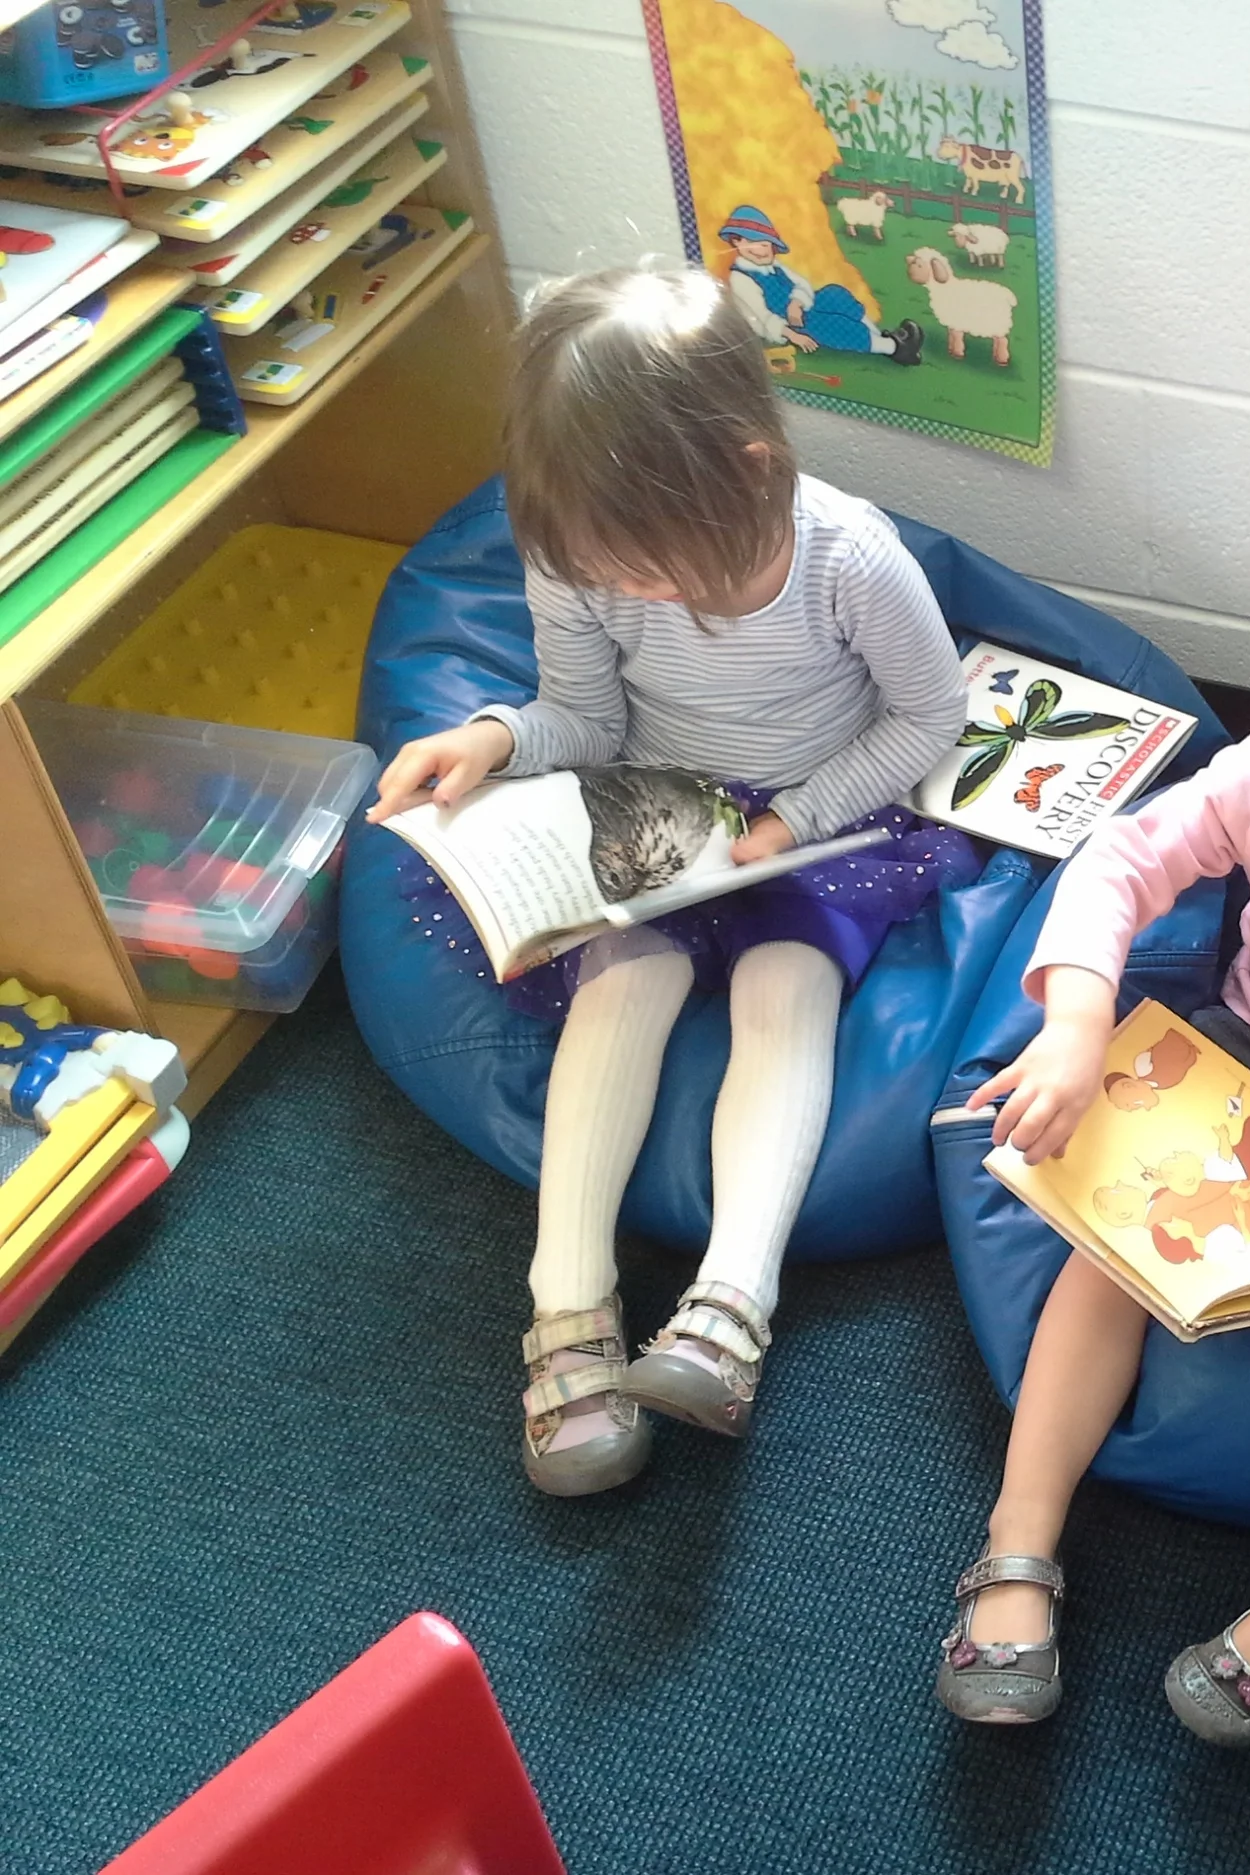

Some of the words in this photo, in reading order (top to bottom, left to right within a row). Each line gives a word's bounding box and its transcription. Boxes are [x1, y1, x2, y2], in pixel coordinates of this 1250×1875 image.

[965, 654, 995, 686] Butte
[1035, 707, 1161, 839] DISCOVERY
[1102, 725, 1170, 799] SCHOLASTIC
[1059, 800, 1105, 848] FIRST
